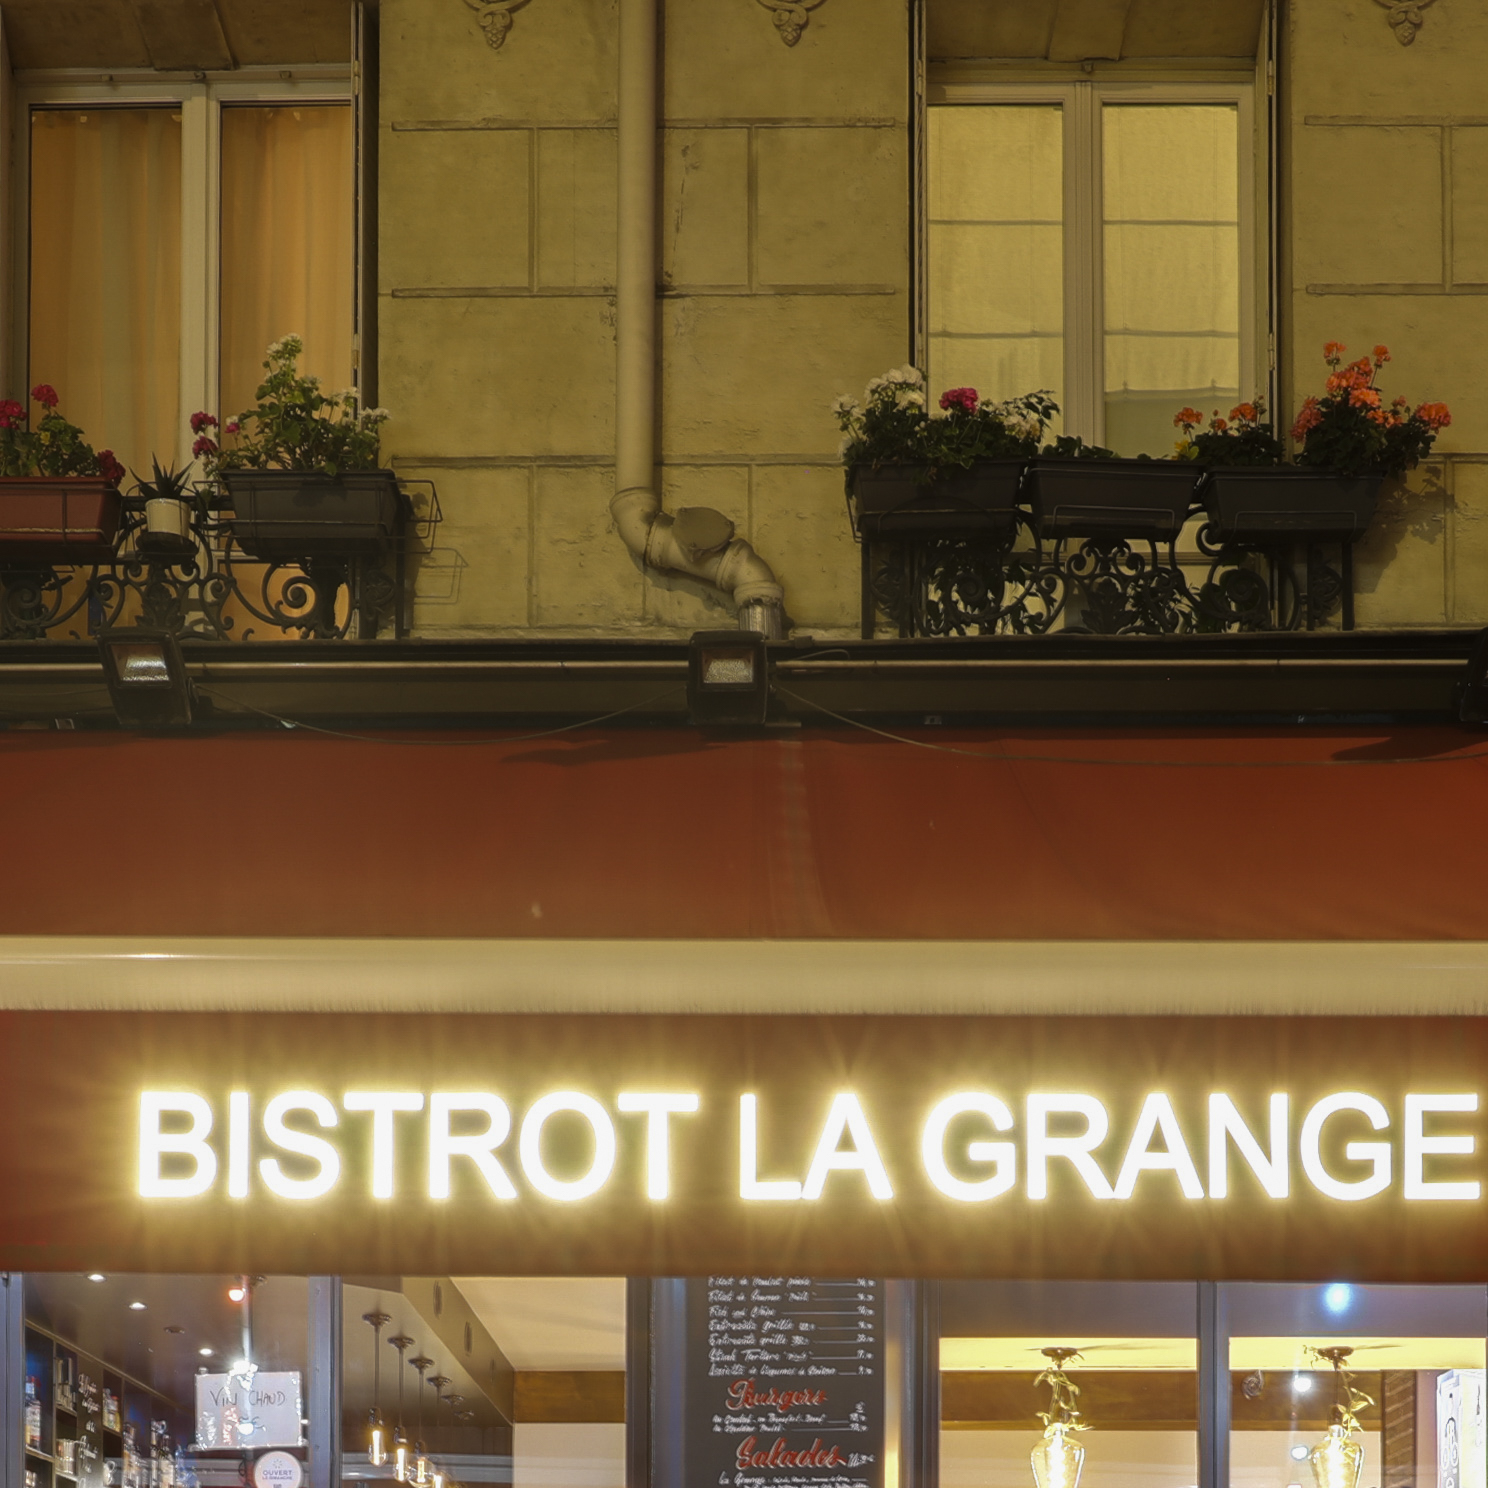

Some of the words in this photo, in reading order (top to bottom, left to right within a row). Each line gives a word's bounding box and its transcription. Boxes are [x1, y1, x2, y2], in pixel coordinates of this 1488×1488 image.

[134, 1090, 700, 1200] BISTROT
[737, 1090, 893, 1200] LA
[921, 1088, 1482, 1202] GRANGE
[210, 1390, 238, 1406] VIN
[248, 1390, 285, 1406] CHAUD
[725, 1376, 828, 1413] Burgers
[736, 1434, 848, 1470] Salades
